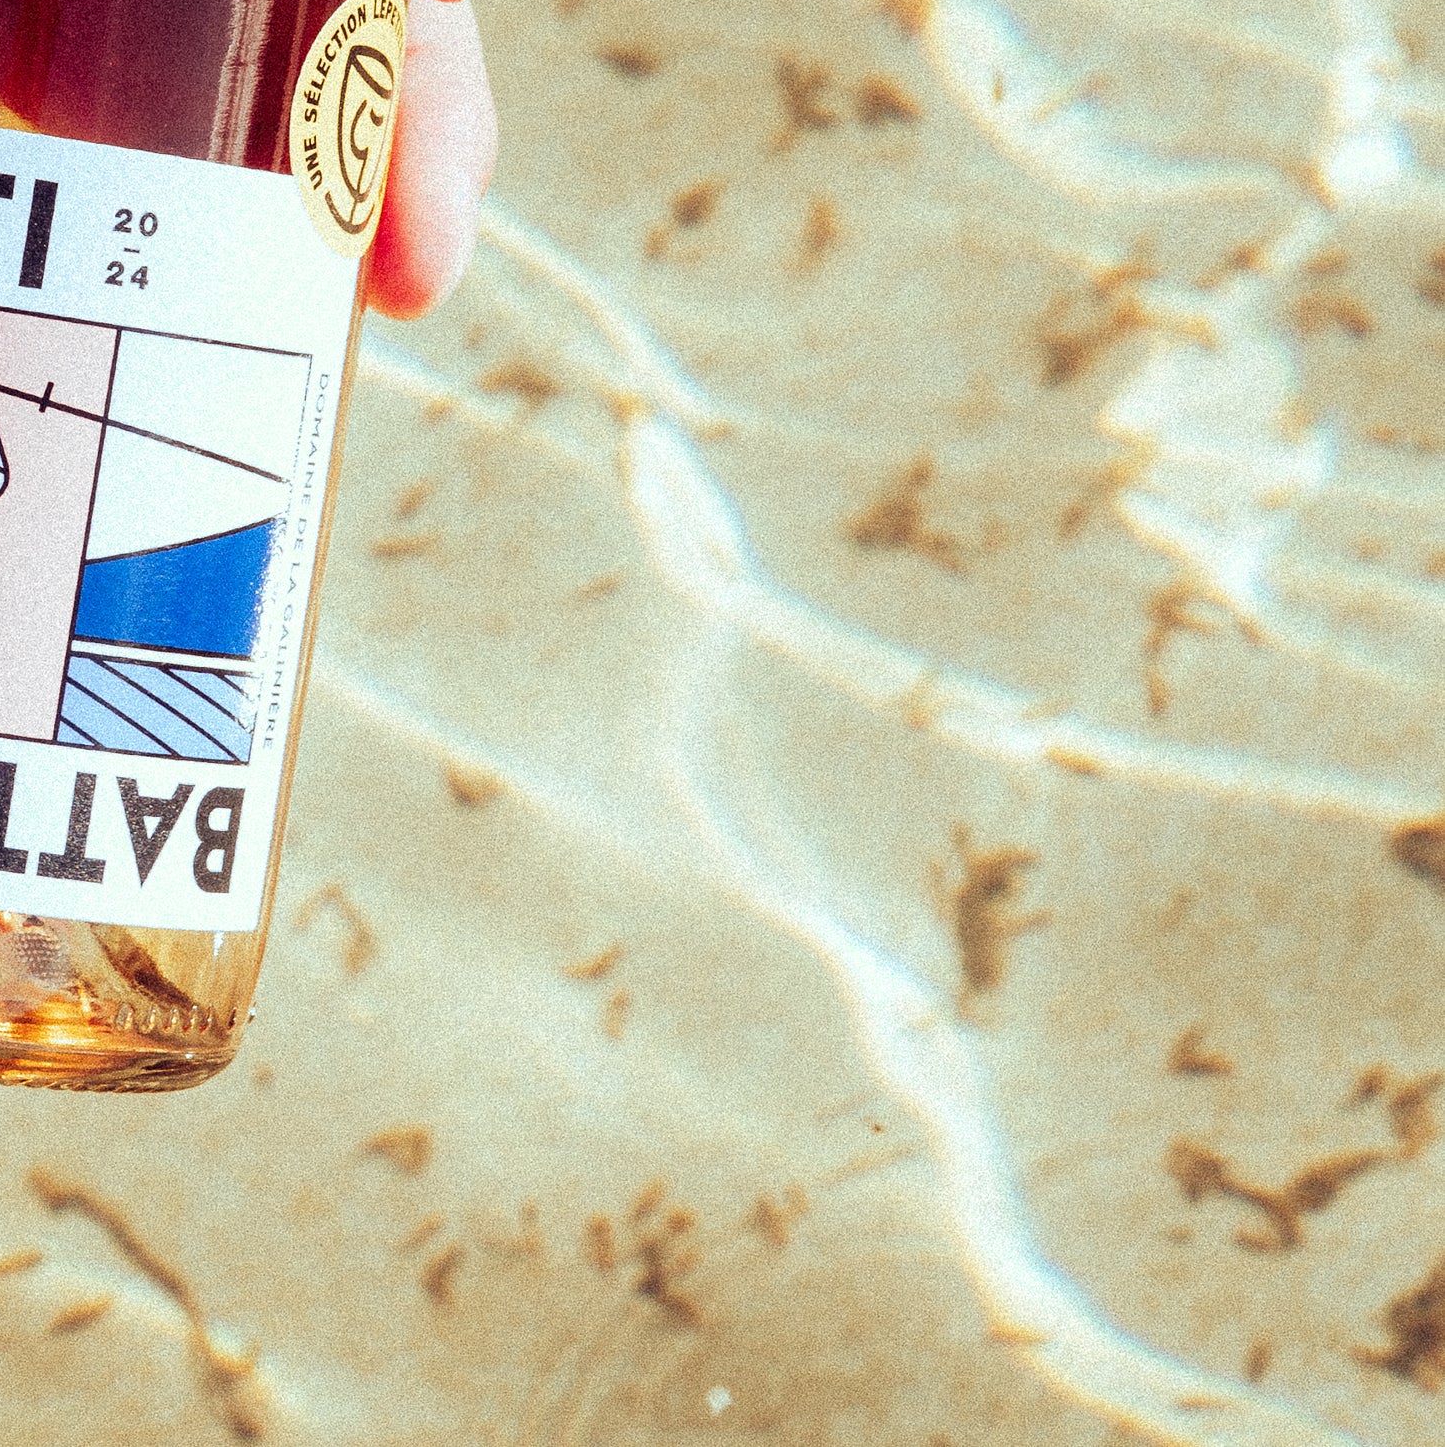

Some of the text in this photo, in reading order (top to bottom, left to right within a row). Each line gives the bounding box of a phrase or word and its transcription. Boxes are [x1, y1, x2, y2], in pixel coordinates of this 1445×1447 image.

[304, 2, 367, 124] SÉLECTION
[303, 133, 324, 190] UNE
[113, 208, 159, 237] 20
[105, 260, 149, 290] 24
[301, 372, 330, 505] DOMAINE
[293, 517, 307, 551] DE
[287, 562, 301, 594] LA
